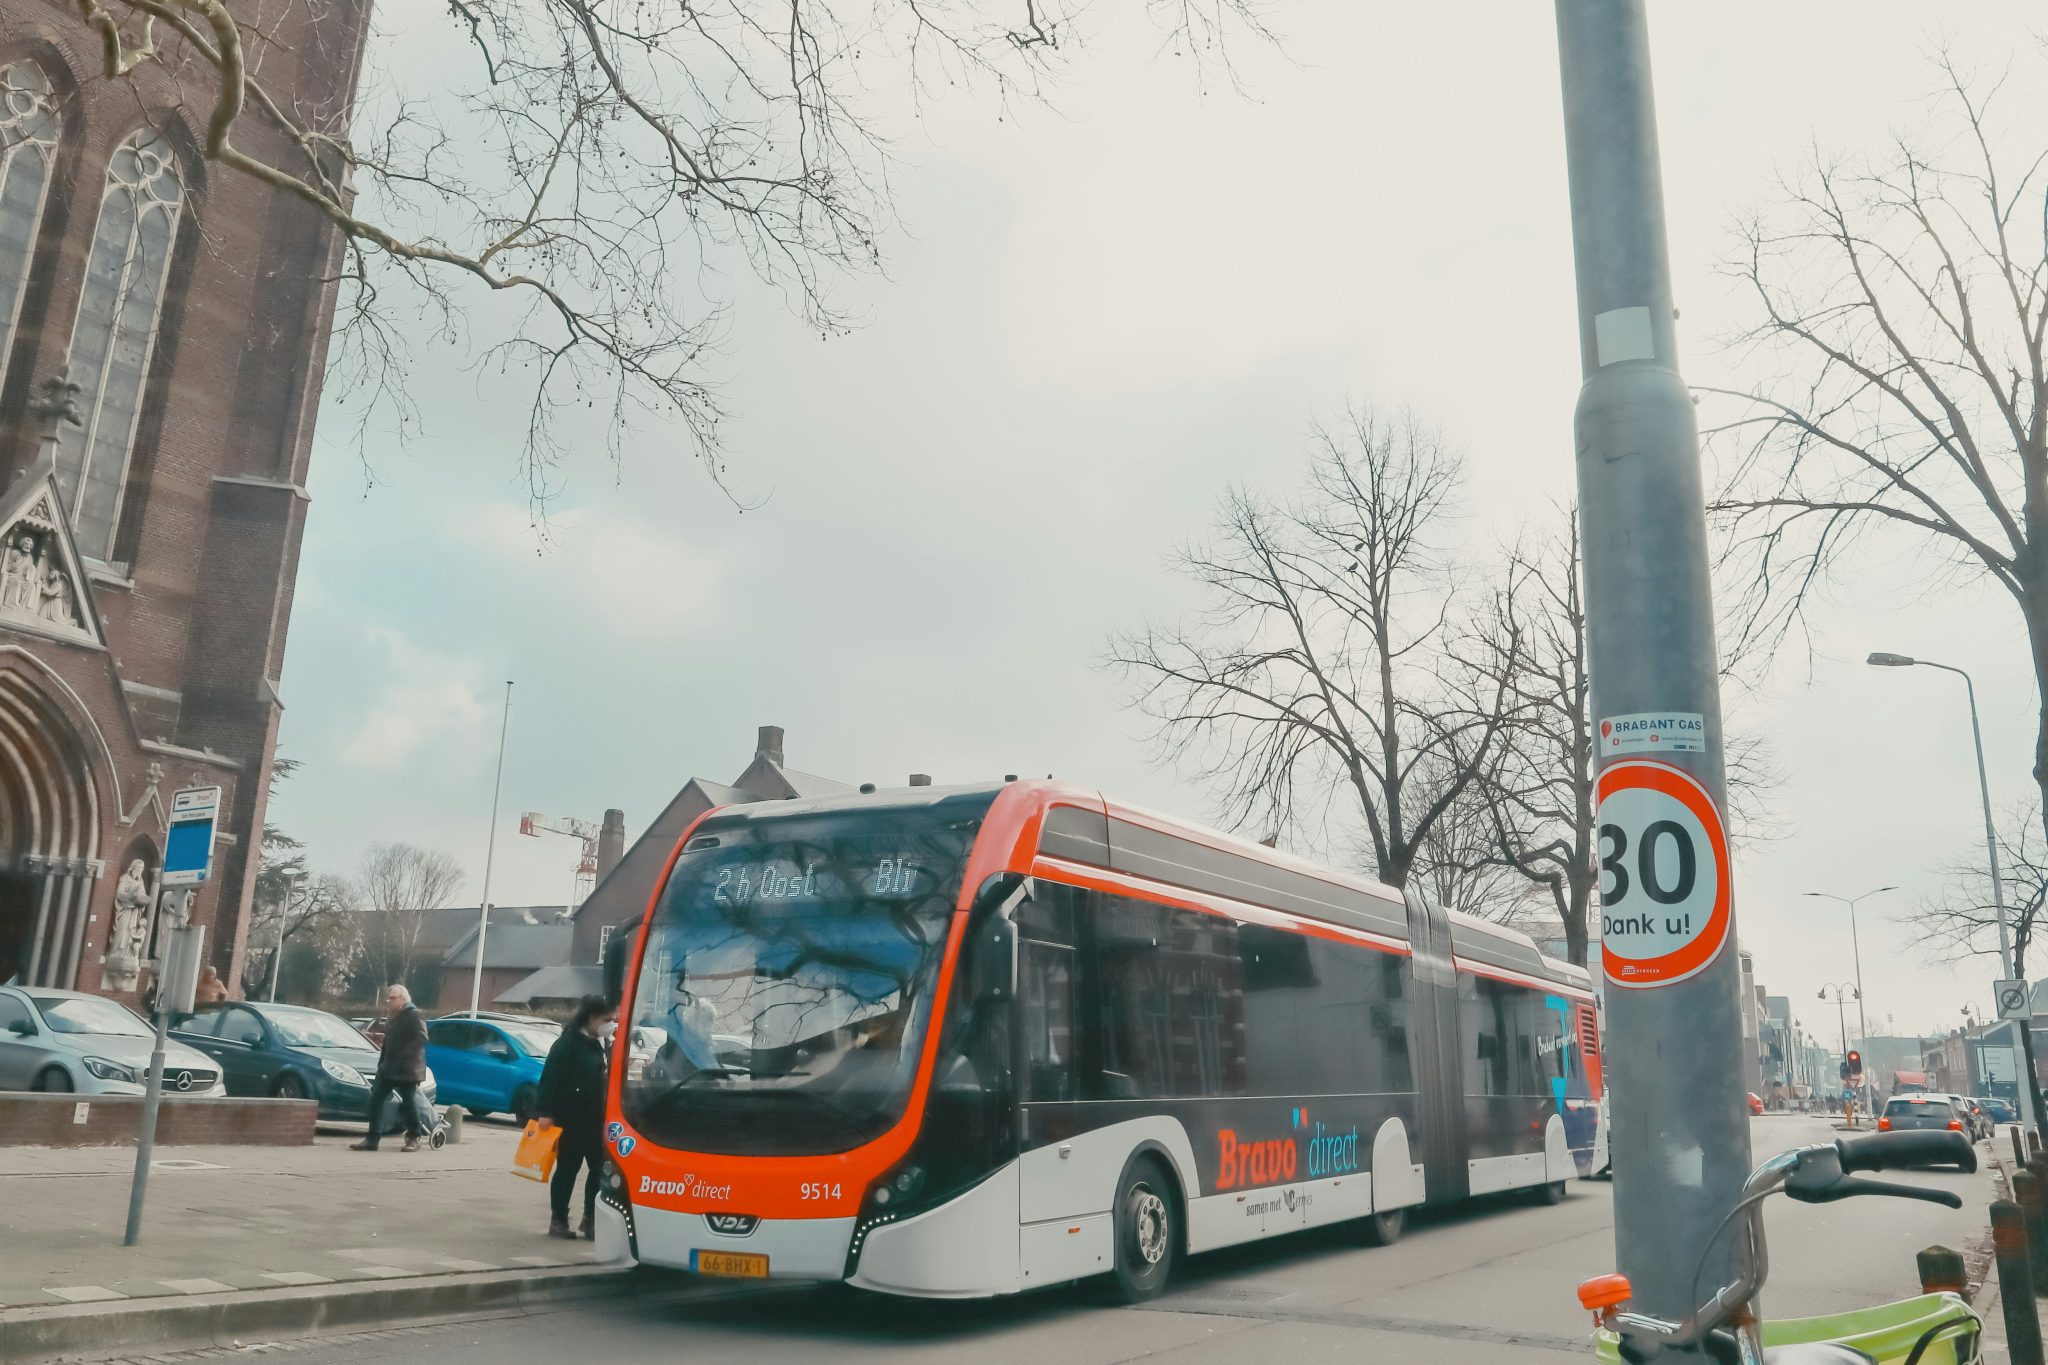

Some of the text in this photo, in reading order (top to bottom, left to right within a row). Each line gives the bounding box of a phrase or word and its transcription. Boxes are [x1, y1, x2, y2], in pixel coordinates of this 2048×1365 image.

[1615, 719, 1702, 733] BRABANT GAS
[1599, 819, 1697, 907] 30
[759, 863, 816, 899] Oost
[1603, 912, 1690, 936] Dank u!
[1215, 1121, 1358, 1190] Bravo direct
[638, 1175, 732, 1201] Bravo direct
[800, 1182, 842, 1200] 9514
[1246, 1201, 1269, 1217] samen
[1269, 1196, 1282, 1213] met
[711, 1215, 750, 1230] VDL
[703, 1256, 762, 1275] 66-BHX-1
